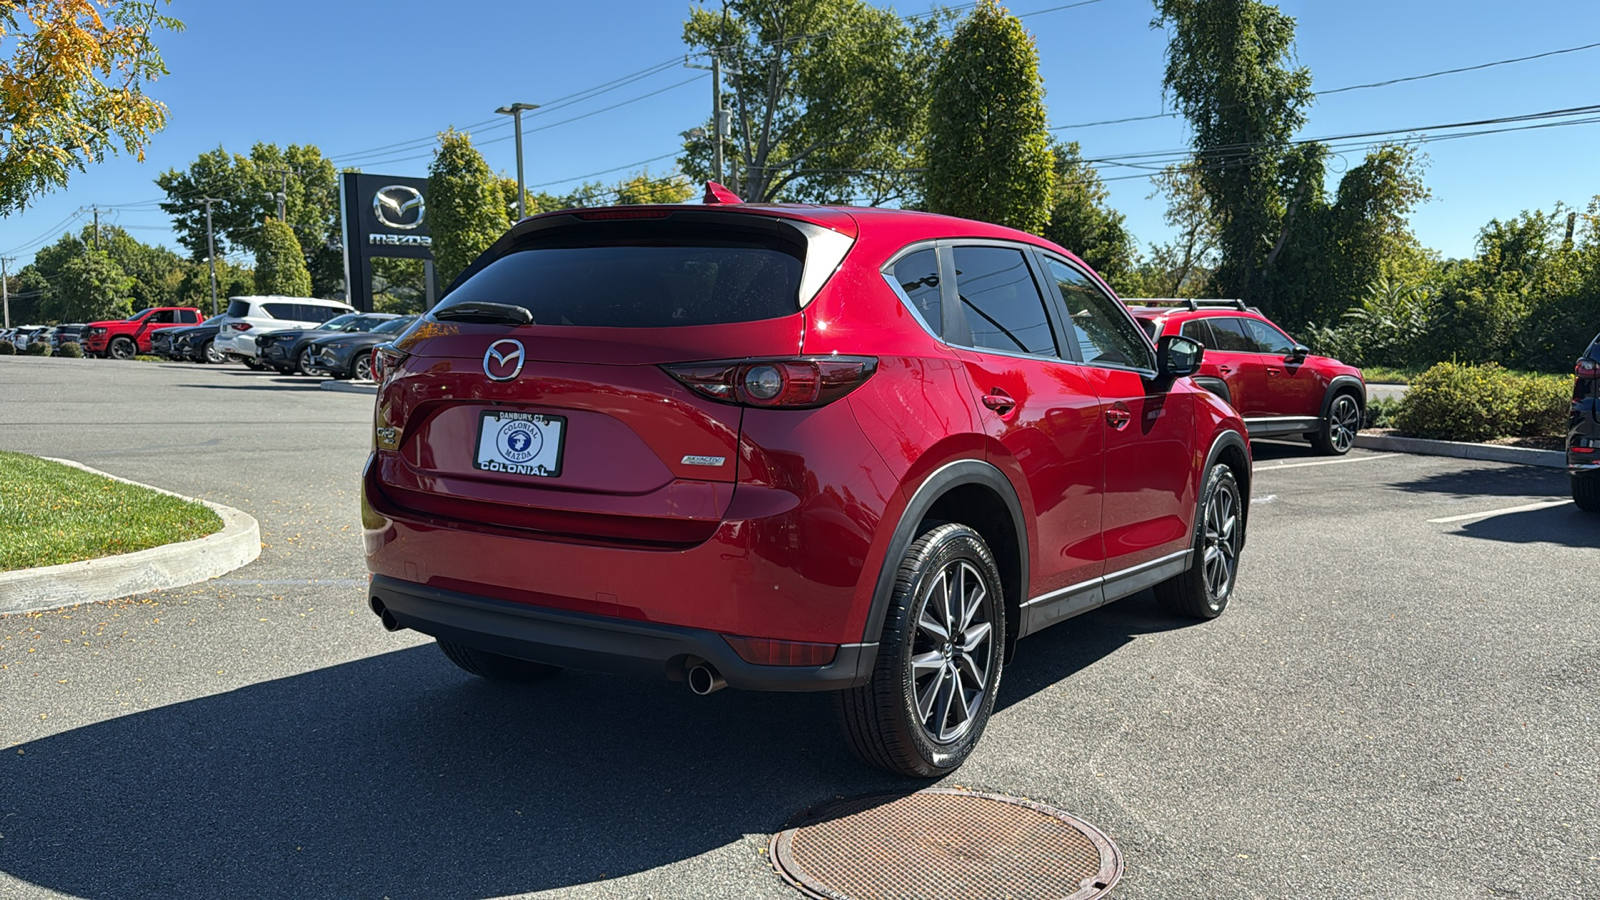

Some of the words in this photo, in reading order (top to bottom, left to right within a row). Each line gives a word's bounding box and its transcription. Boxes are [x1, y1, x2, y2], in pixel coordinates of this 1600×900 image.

[534, 414, 544, 422] CT
[503, 422, 539, 439] COLONIAL
[505, 449, 532, 460] MAZDA
[481, 461, 548, 476] COLONIAL
